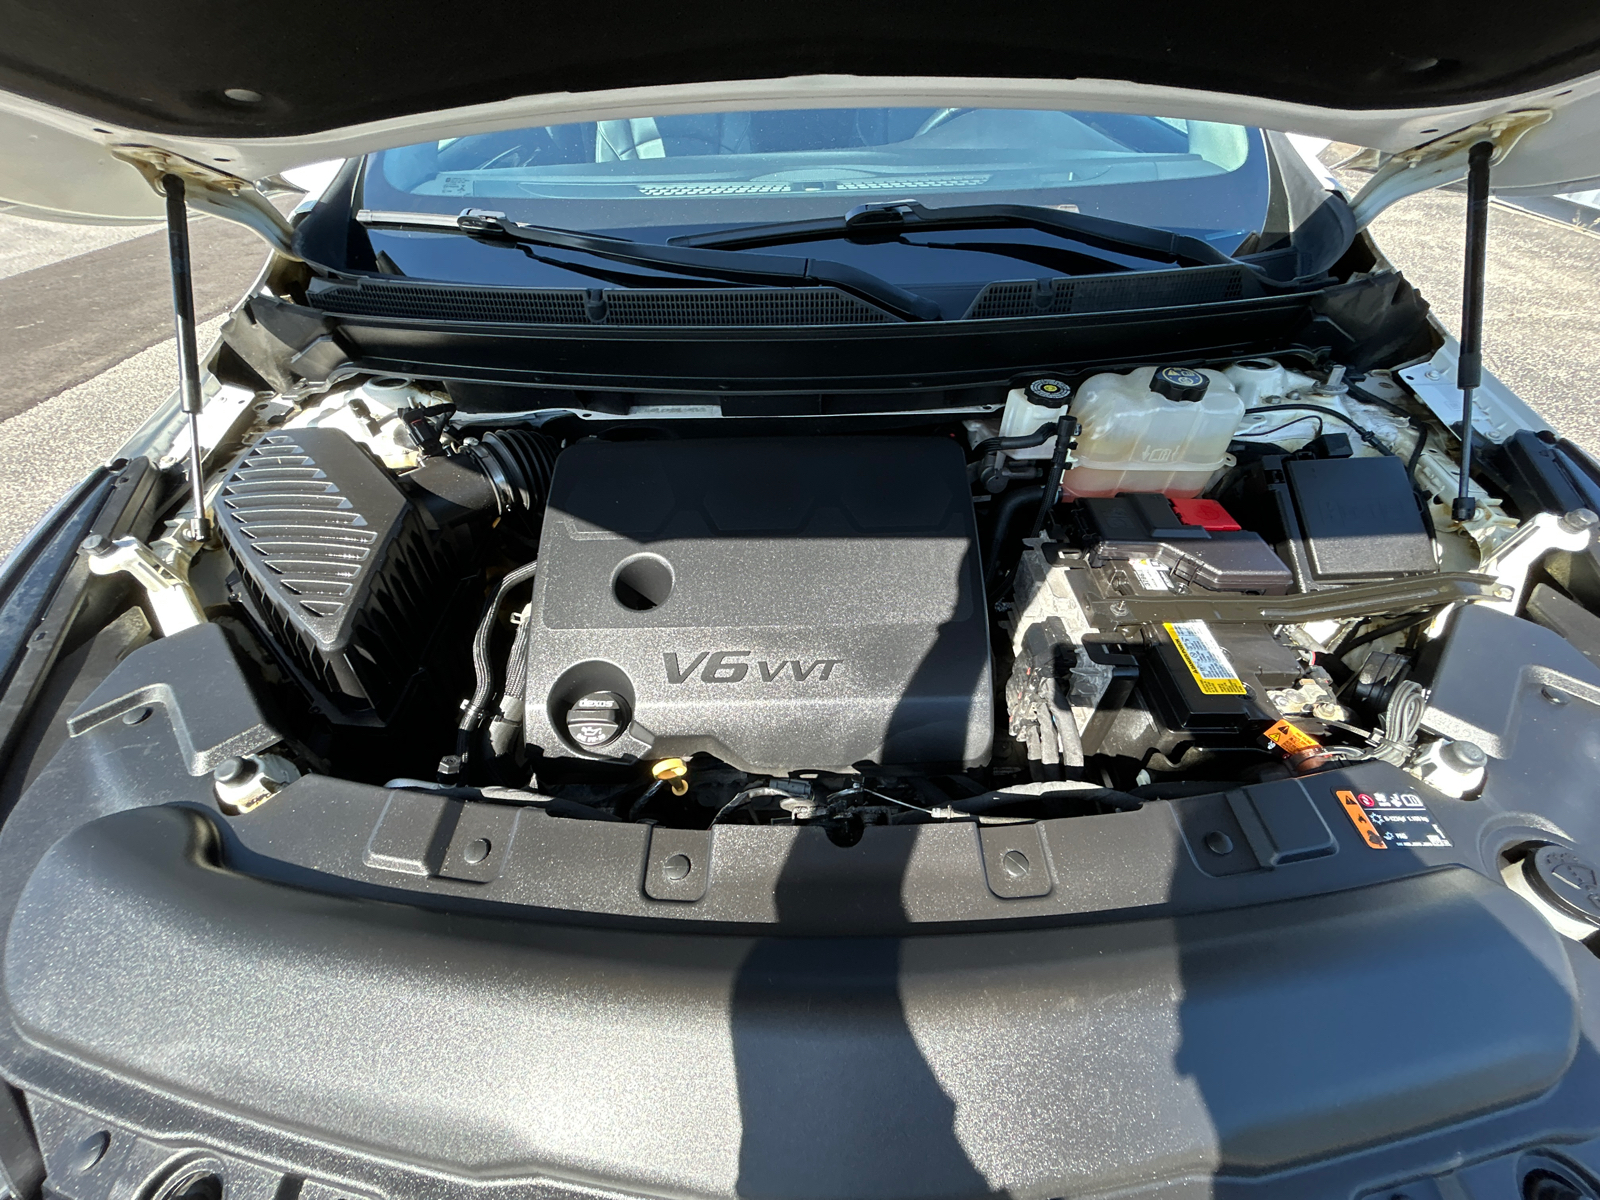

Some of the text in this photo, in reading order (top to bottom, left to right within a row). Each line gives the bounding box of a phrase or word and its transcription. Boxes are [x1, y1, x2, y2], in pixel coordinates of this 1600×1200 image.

[662, 650, 844, 684] V6 VVT
[579, 698, 614, 708] dexos
